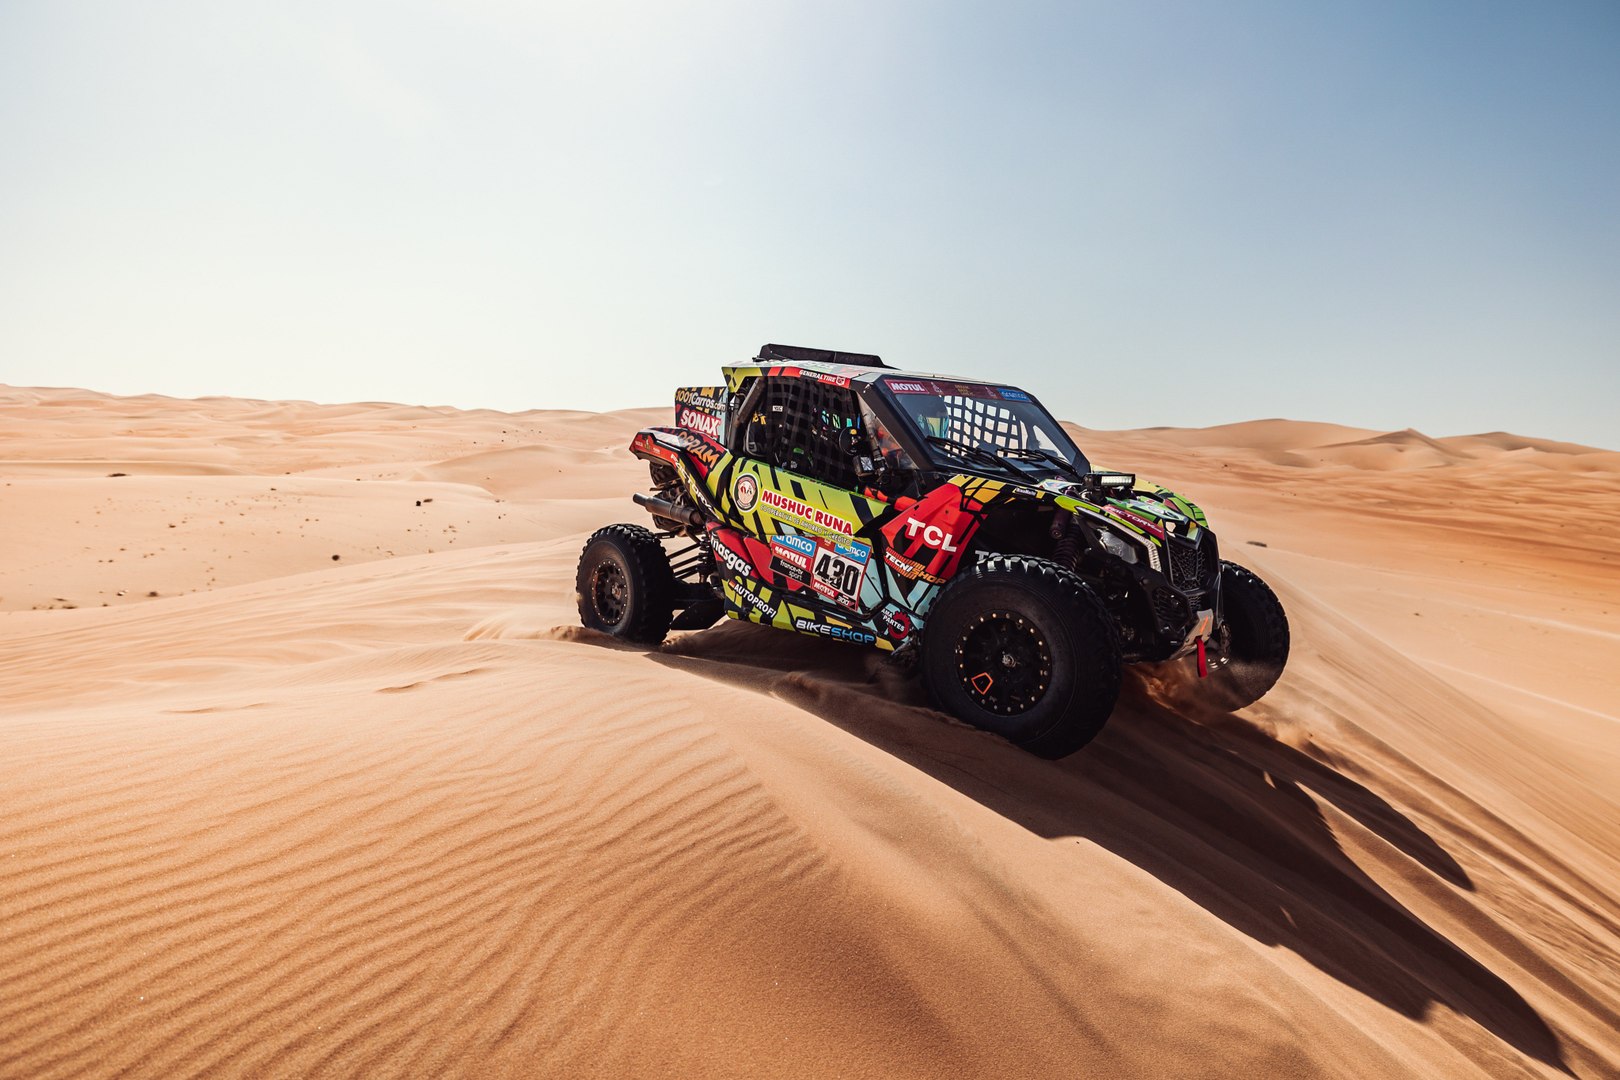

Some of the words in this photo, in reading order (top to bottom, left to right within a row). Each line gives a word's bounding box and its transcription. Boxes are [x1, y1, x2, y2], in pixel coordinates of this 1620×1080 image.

[799, 369, 823, 380] GENERAL
[822, 374, 836, 383] TIRE
[890, 382, 925, 392] MOTUL
[681, 409, 719, 436] SONAX
[761, 490, 813, 520] MUSHUC
[814, 510, 853, 536] RUNA
[907, 517, 957, 552] TCL
[775, 546, 807, 568] MOTUL
[814, 553, 860, 596] 430
[734, 584, 776, 618] AUTOPROFI
[814, 581, 835, 598] MOTUL
[881, 608, 893, 618] AMA
[882, 615, 905, 632] PARTES
[796, 619, 875, 643] BIKESHOP
